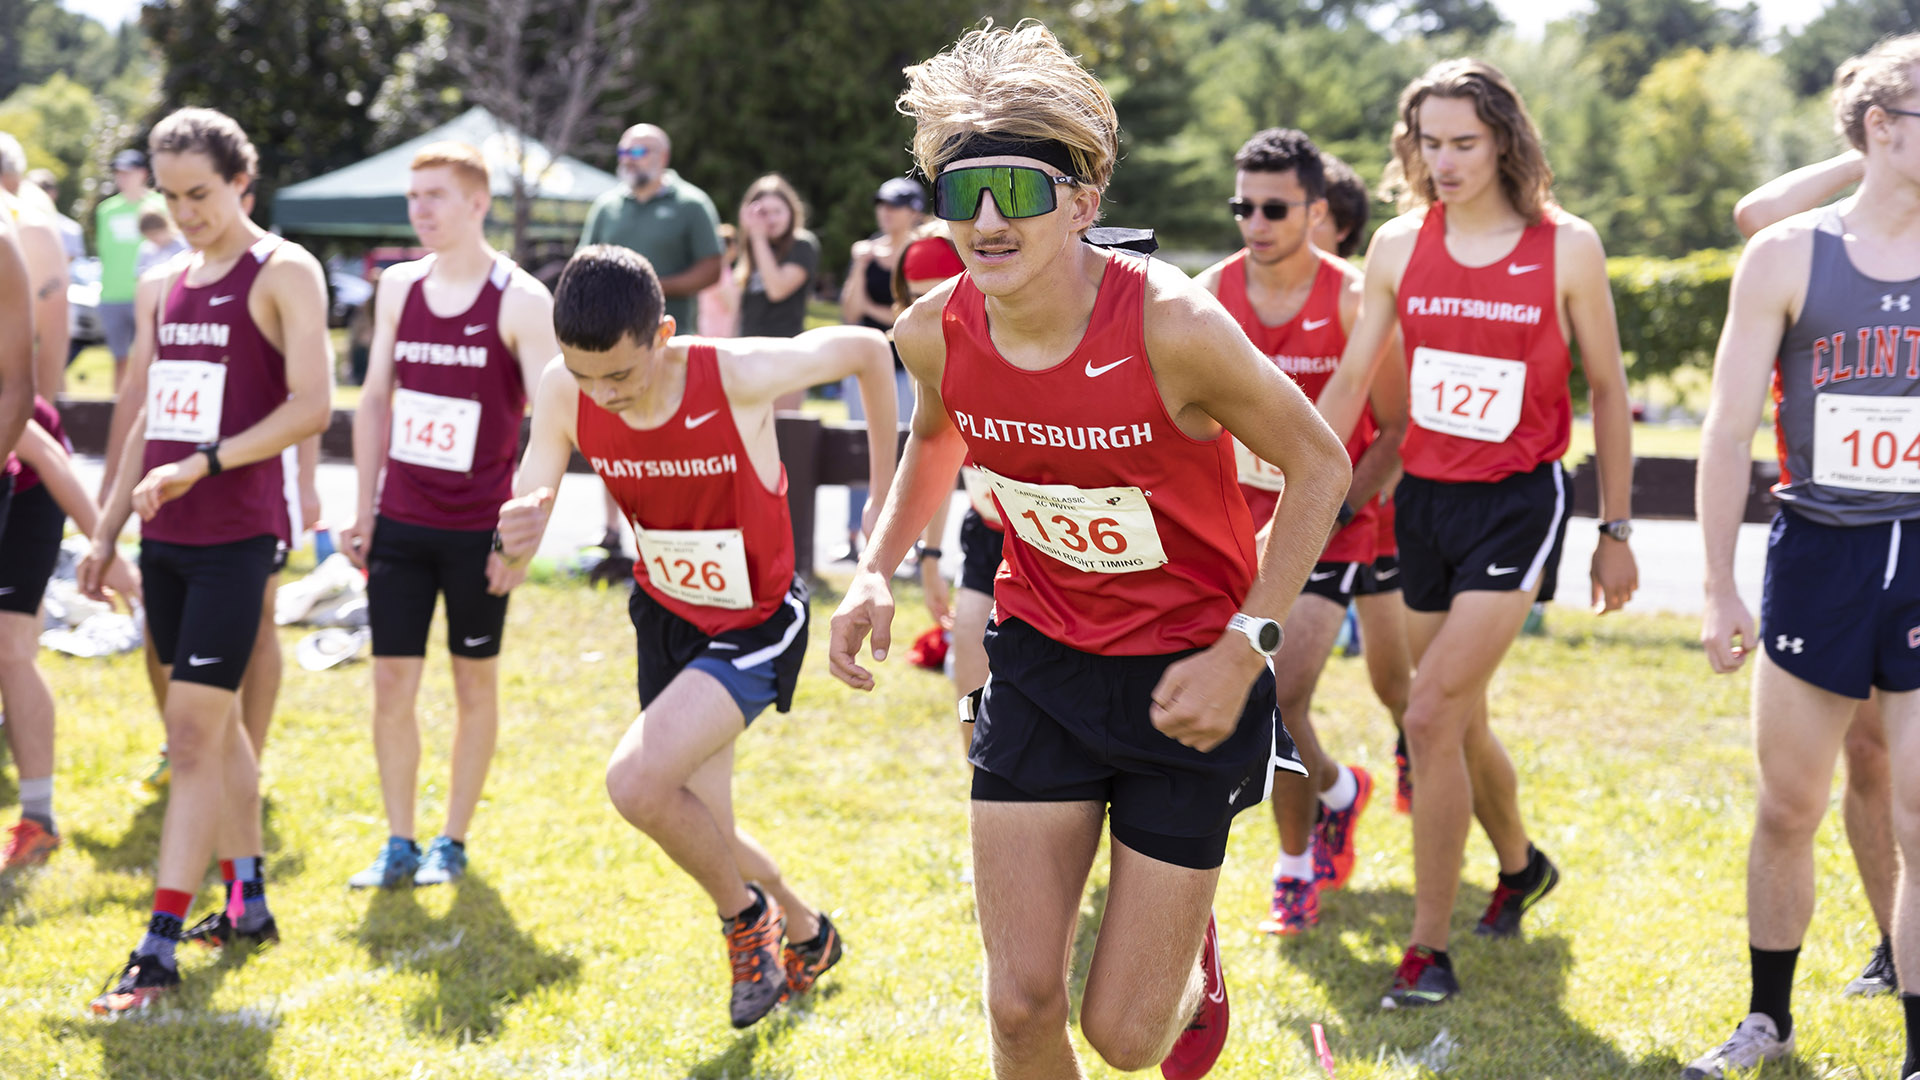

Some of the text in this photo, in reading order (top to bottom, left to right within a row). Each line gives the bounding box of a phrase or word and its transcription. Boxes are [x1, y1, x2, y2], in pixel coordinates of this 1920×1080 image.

[1406, 296, 1542, 325] PLATTSBURGH
[394, 340, 488, 369] POTSDAM
[156, 388, 200, 422] 144
[1431, 380, 1499, 420] 127
[405, 417, 457, 452] 143
[954, 410, 1153, 450] PLATTSBURGH
[1842, 429, 1920, 470] 104
[590, 454, 738, 480] PLATTSBURGH
[1051, 496, 1086, 504] CLASSIC
[1021, 509, 1128, 555] 136
[653, 556, 726, 592] 126
[1062, 552, 1096, 569] RIGHT
[1098, 558, 1144, 568] TIMING
